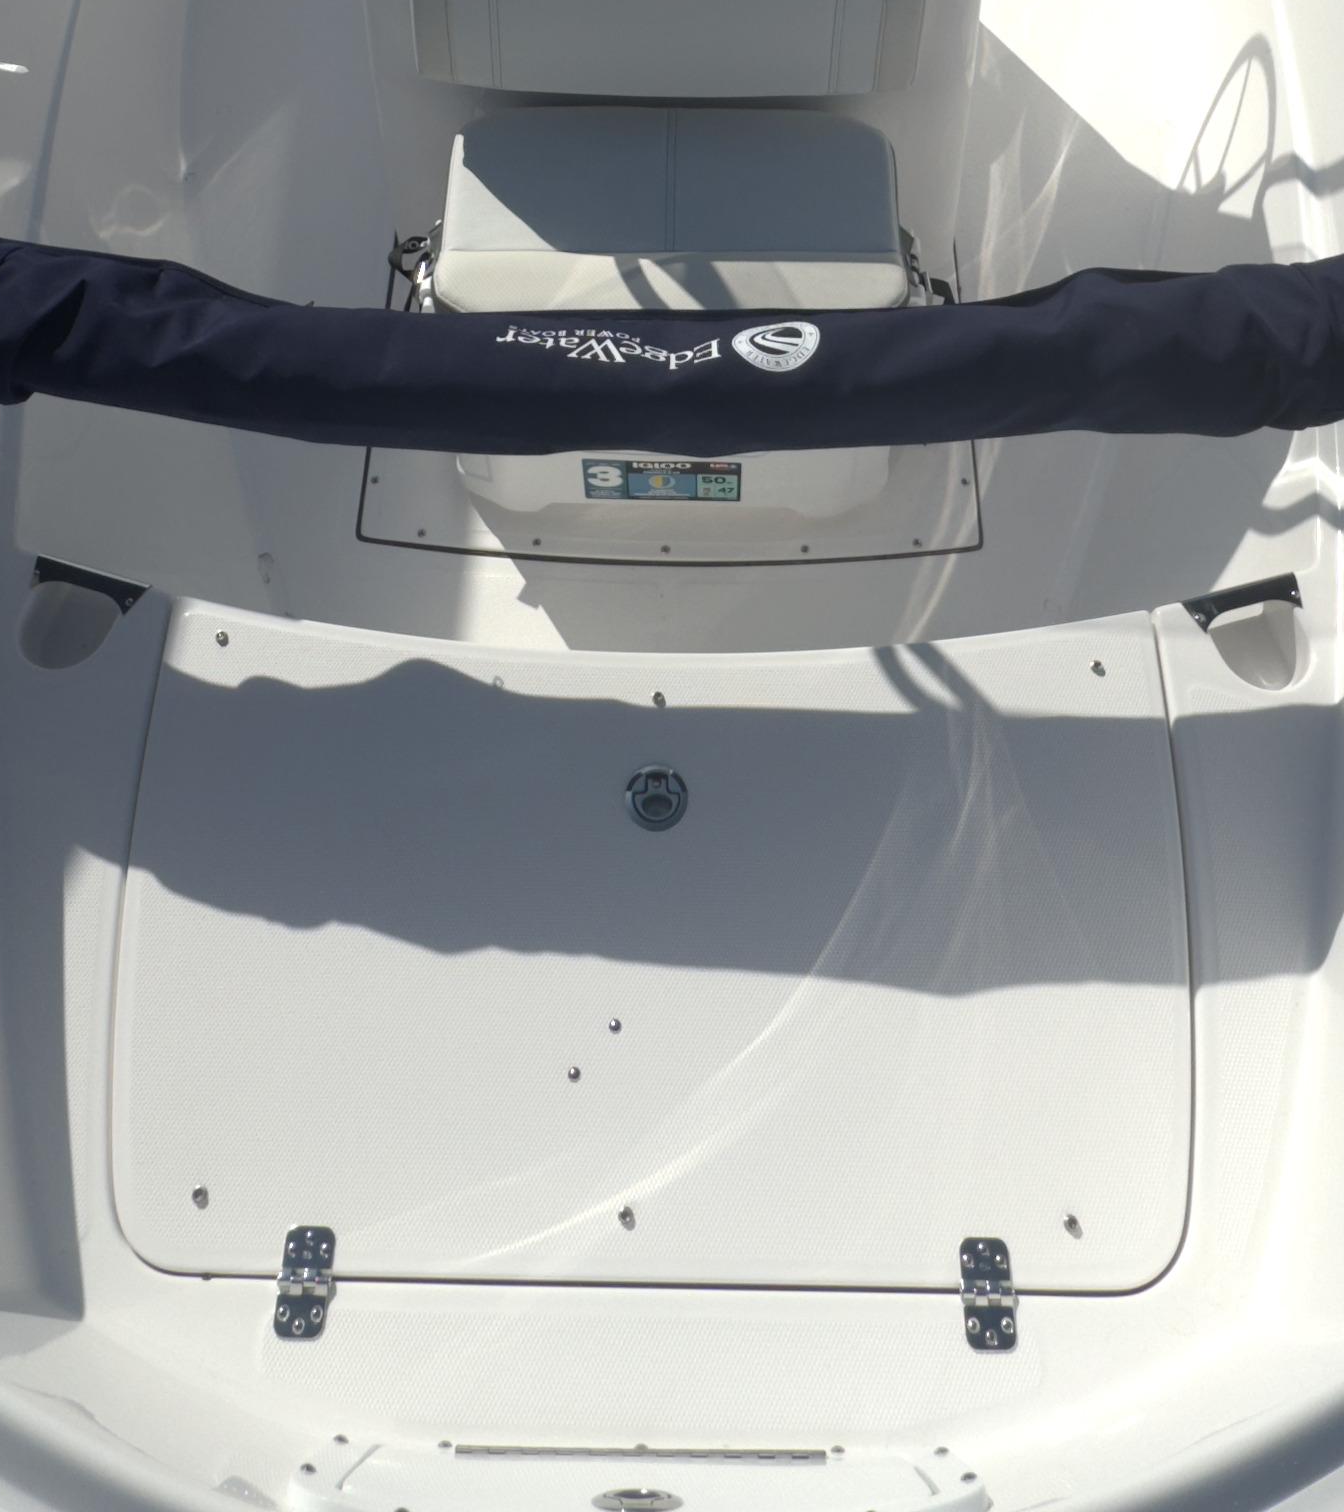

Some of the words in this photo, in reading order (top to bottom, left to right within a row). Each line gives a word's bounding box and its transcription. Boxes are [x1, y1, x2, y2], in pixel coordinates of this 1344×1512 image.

[574, 329, 641, 343] POWER
[496, 330, 721, 370] EdgeWater
[587, 465, 624, 488] 3
[701, 476, 727, 484] 50
